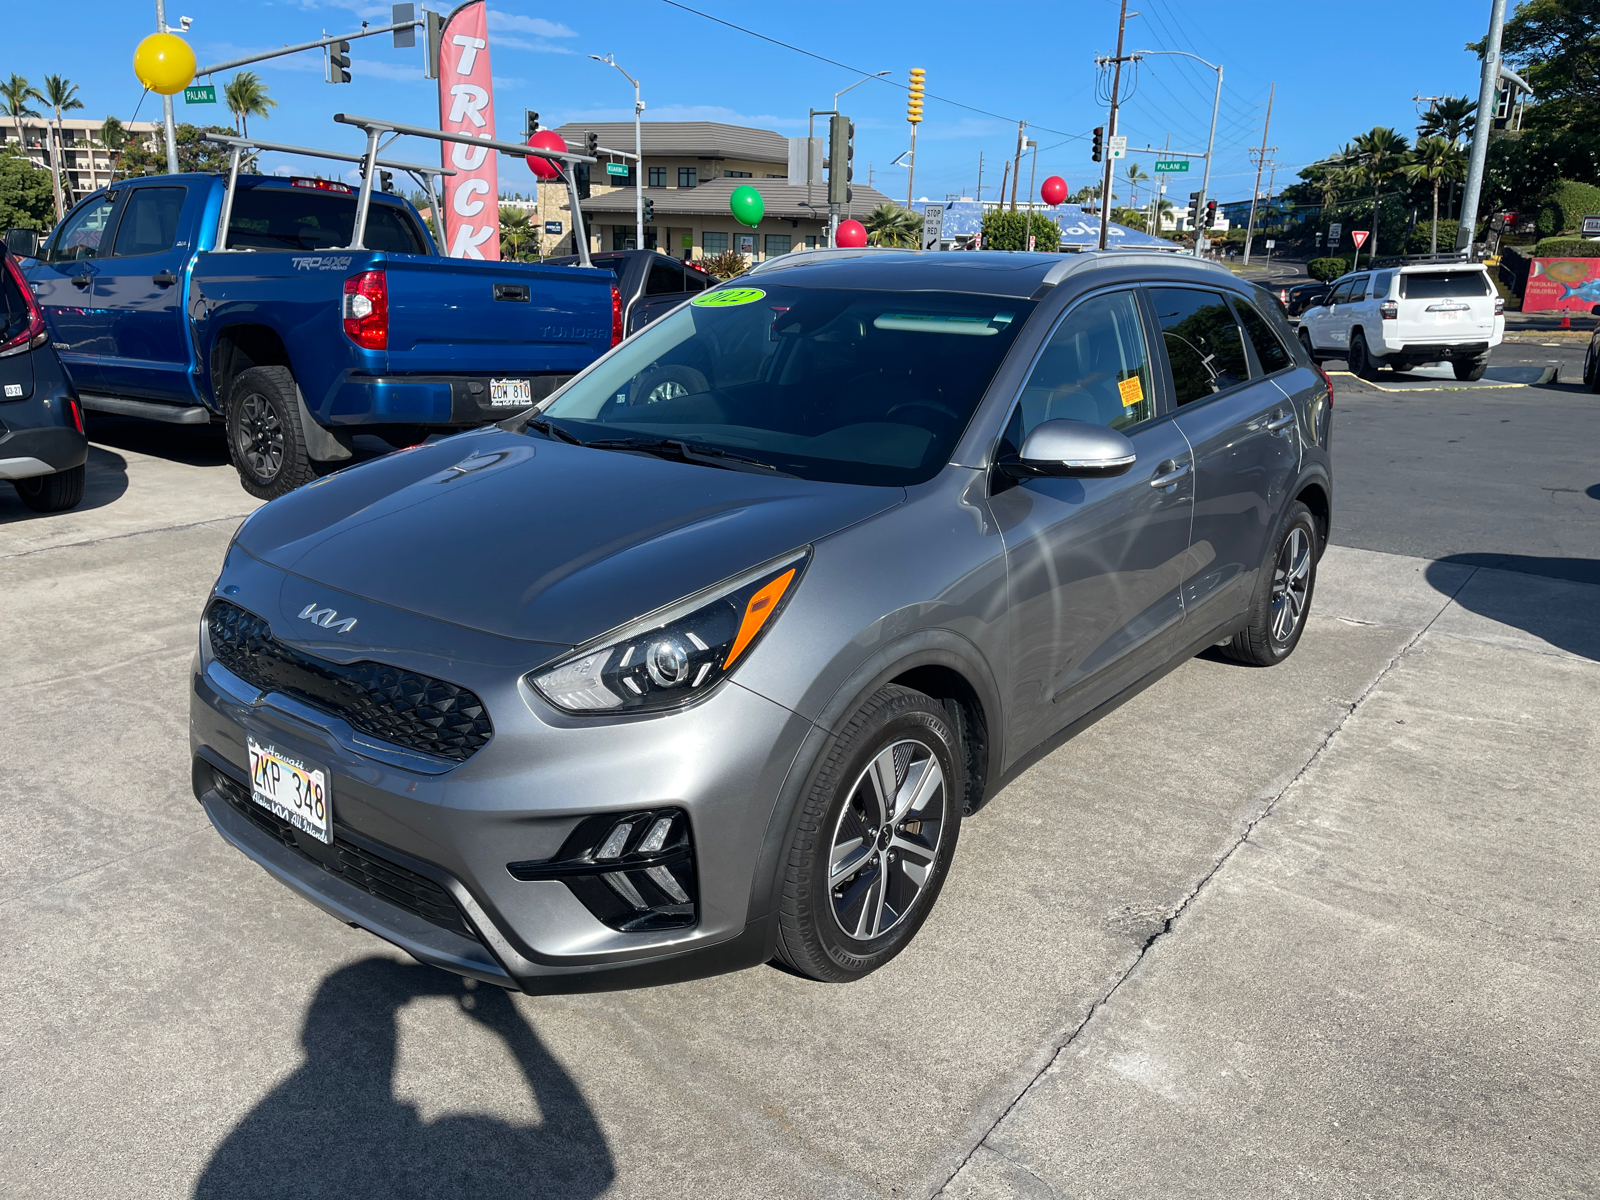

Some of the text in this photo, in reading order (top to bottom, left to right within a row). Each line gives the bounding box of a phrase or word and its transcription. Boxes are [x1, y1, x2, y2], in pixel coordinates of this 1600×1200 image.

[186, 90, 208, 100] PALANI
[448, 34, 495, 260] TRUCK
[927, 209, 941, 218] STOP
[927, 226, 938, 235] RED
[292, 257, 322, 270] TRD
[698, 291, 756, 303] 2022
[540, 326, 608, 338] TUNDRA
[514, 384, 529, 398] 810
[298, 602, 358, 634] KIA
[264, 745, 304, 770] Hawaii
[251, 750, 324, 820] ZKP 348
[252, 792, 270, 810] Aloha
[291, 812, 302, 829] All
[303, 820, 328, 844] Islands
[832, 947, 874, 968] MICHELIN
